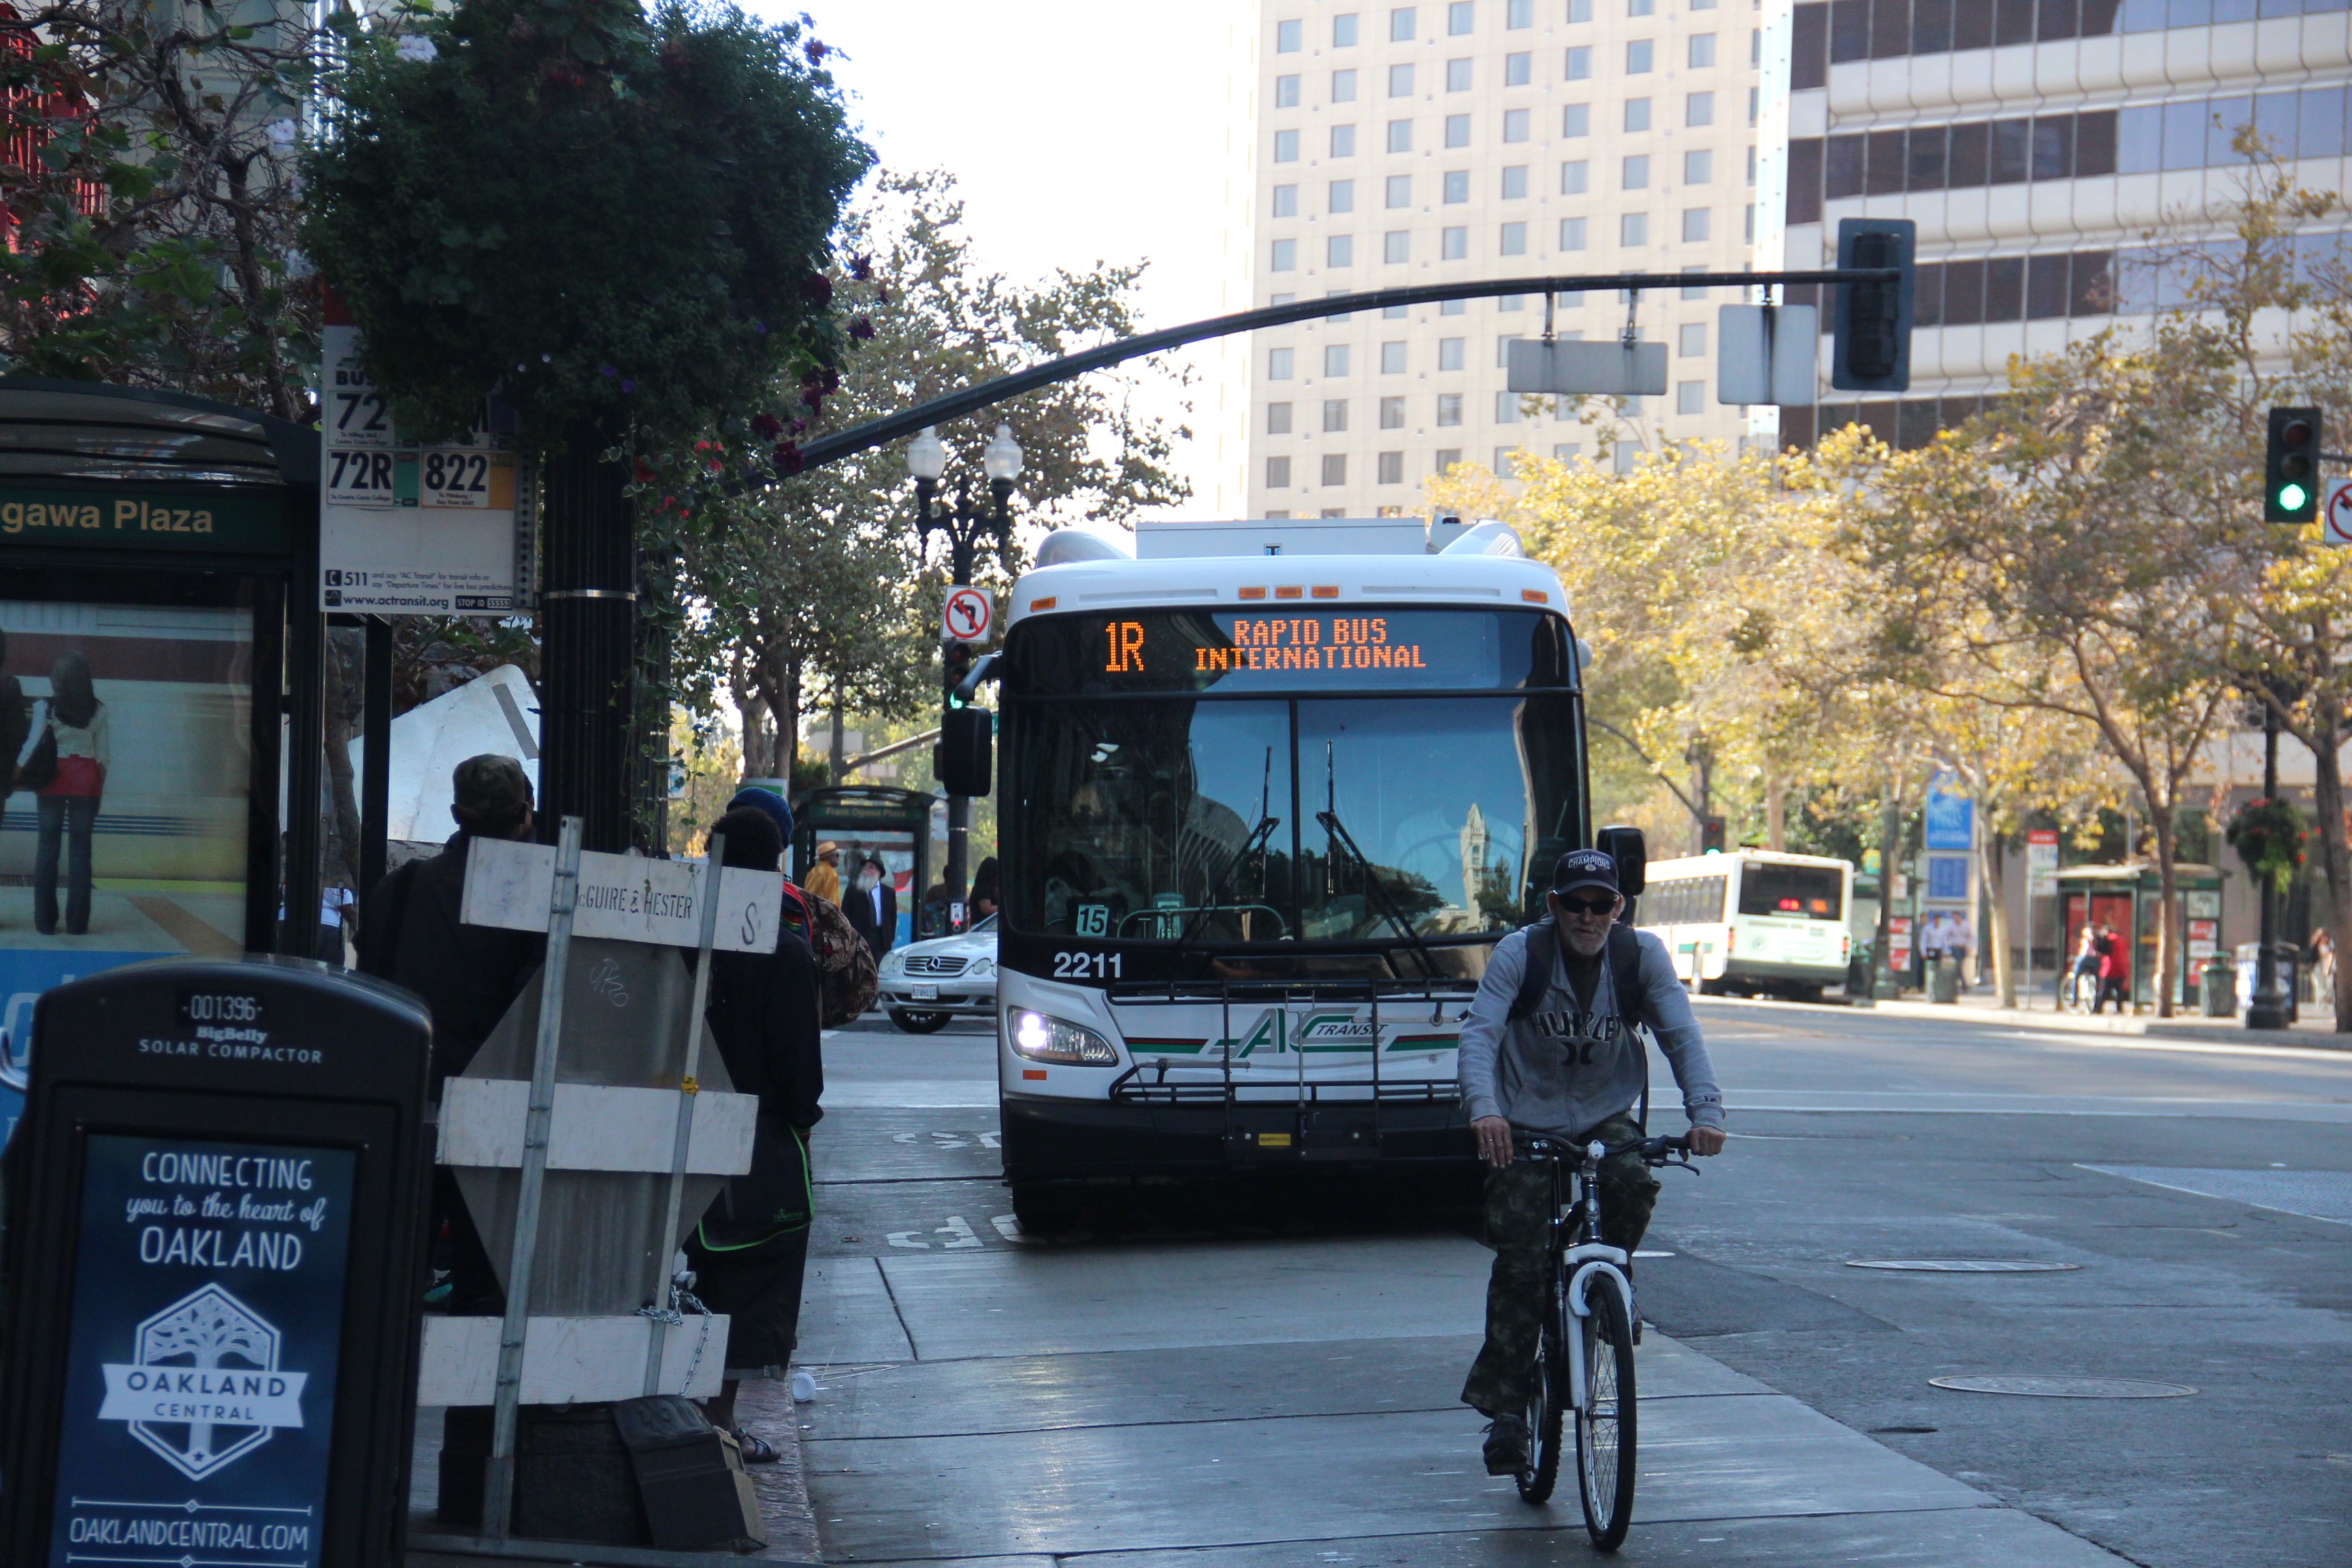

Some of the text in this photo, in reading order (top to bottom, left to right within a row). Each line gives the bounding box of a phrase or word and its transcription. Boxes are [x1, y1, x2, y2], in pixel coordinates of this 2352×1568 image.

[336, 393, 387, 430] 72
[329, 452, 393, 489] 72R
[425, 453, 487, 491] 822
[1, 500, 212, 534] gawa Plaza
[343, 572, 368, 586] 511
[478, 584, 512, 592] predictions
[343, 595, 449, 609] www.actransit.org
[457, 599, 511, 608] STOP ID 55553
[1235, 618, 1386, 644] RAPID BUS
[1105, 621, 1144, 671] 1R
[1196, 645, 1426, 670] INTERNATIONAL
[1568, 856, 1610, 870] CHAMPIONS
[576, 883, 692, 919] cGUIRE & HESTER
[1079, 909, 1105, 934] 15
[1054, 952, 1121, 978] 2211
[191, 995, 256, 1021] 001396
[196, 1026, 268, 1044] BigBelly
[140, 1039, 322, 1063] SOLAR COMPACTOR
[142, 1152, 312, 1191] CONNECTING
[126, 1192, 326, 1231] you to the heart of
[140, 1226, 302, 1270] OAKLAND
[126, 1372, 286, 1398] OAKLAND
[154, 1403, 255, 1421] CENTRAL
[69, 1517, 308, 1552] OAKLANDCENTRAL.COM
